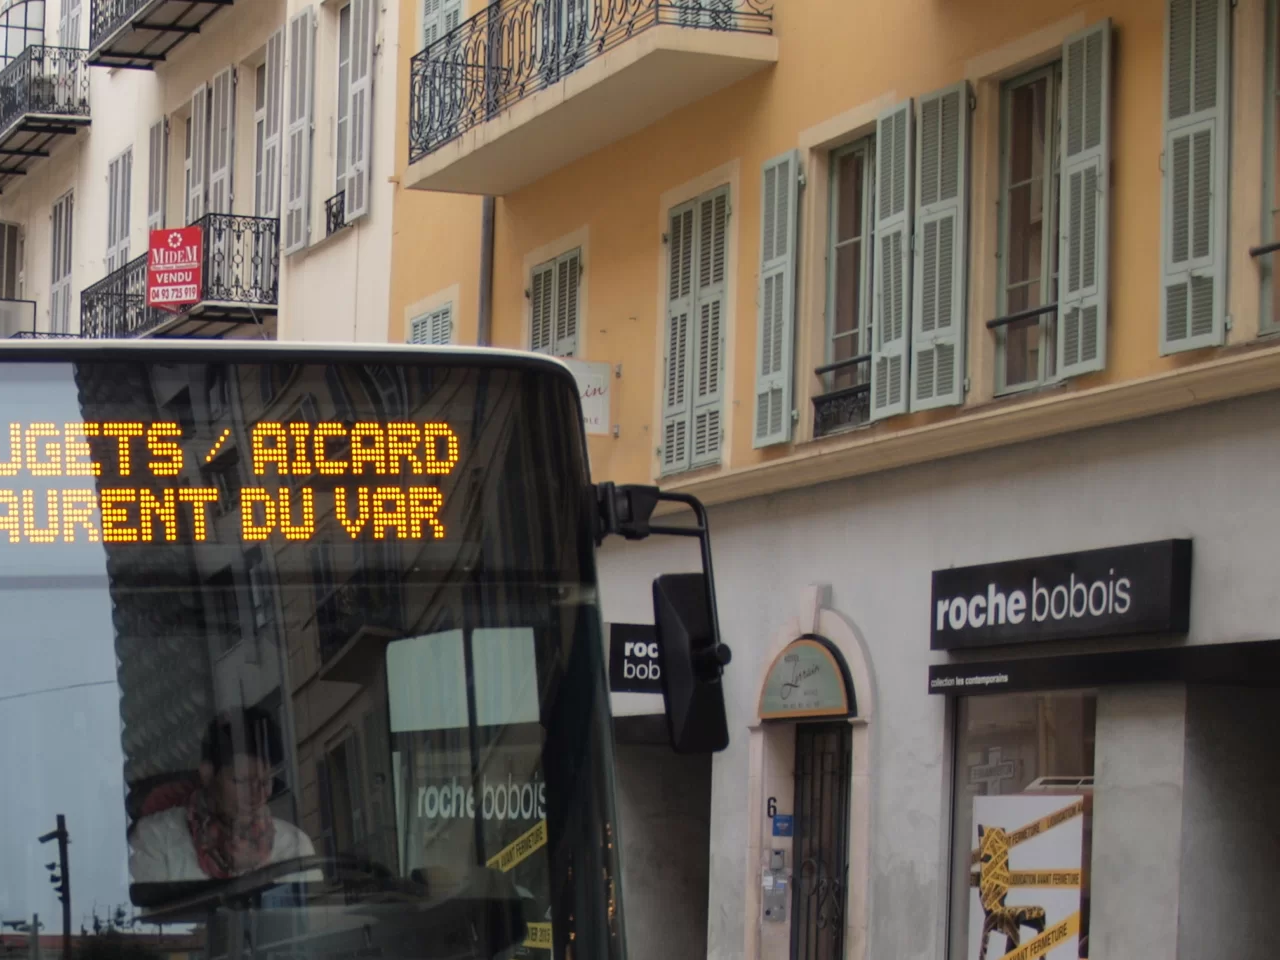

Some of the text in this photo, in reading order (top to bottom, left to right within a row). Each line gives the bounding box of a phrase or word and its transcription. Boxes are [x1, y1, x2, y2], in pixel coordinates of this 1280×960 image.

[156, 271, 193, 284] VENDU
[152, 286, 197, 300] 04 93 725 919
[205, 428, 230, 462] /
[252, 422, 459, 475] AICARD
[241, 487, 315, 541] DU
[334, 486, 444, 540] VAR
[936, 567, 1131, 631] roche bobois
[624, 641, 659, 658] roc
[623, 658, 661, 680] bob
[418, 775, 475, 818] roche
[767, 796, 777, 818] 6
[1029, 922, 1069, 957] FERMETURE
